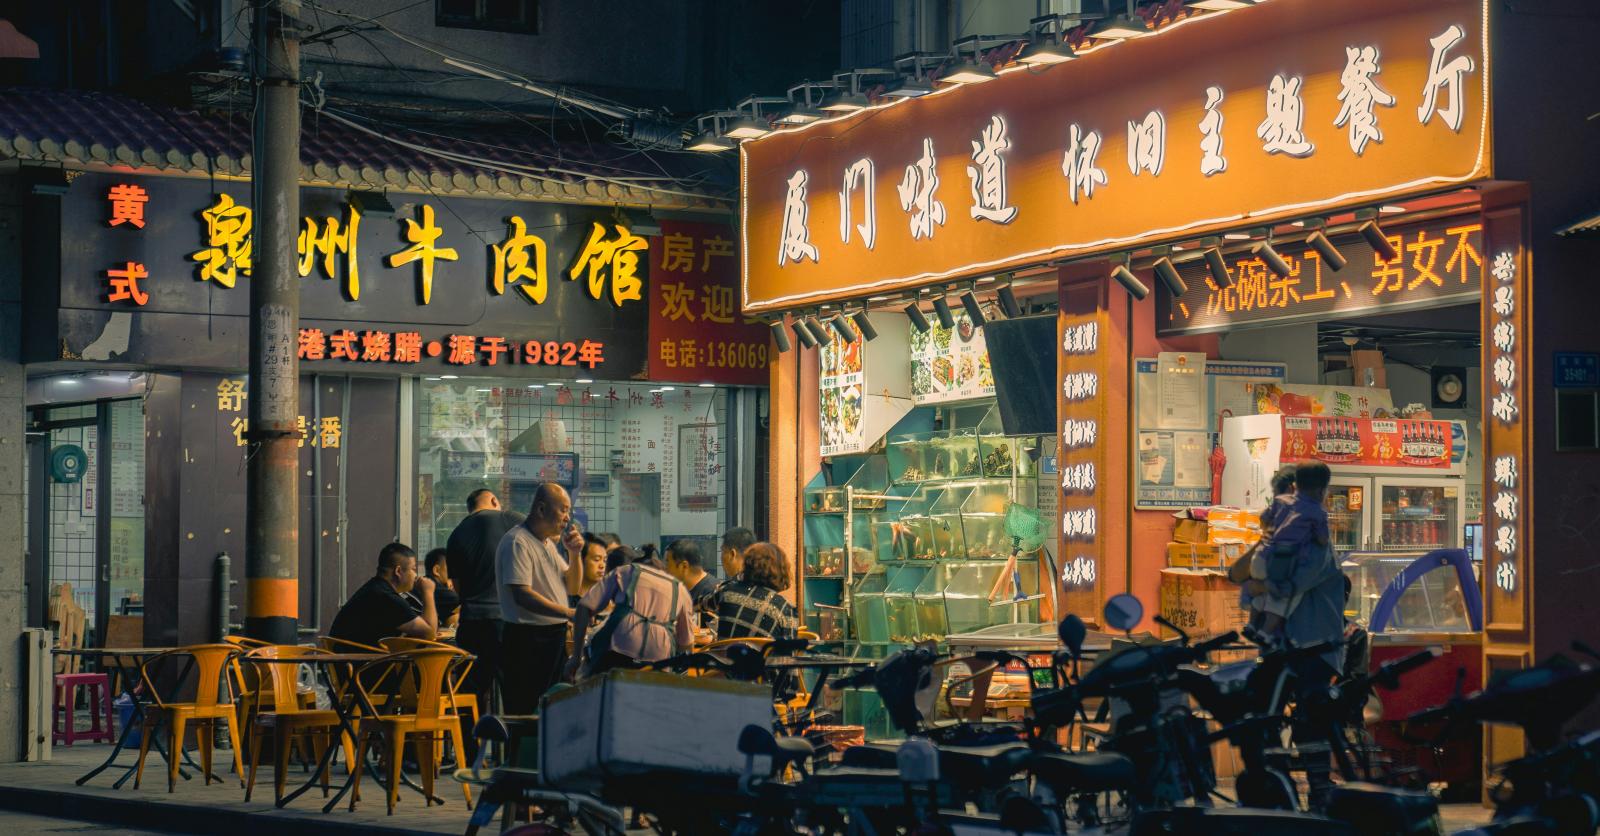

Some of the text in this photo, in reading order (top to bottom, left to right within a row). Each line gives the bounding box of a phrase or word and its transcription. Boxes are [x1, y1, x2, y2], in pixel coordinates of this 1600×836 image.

[777, 24, 1475, 269] 厦门味道 怀旧主题餐厅
[107, 184, 149, 305] 黄式
[192, 193, 649, 307] 泉州牛肉馆
[660, 232, 735, 273] 房产
